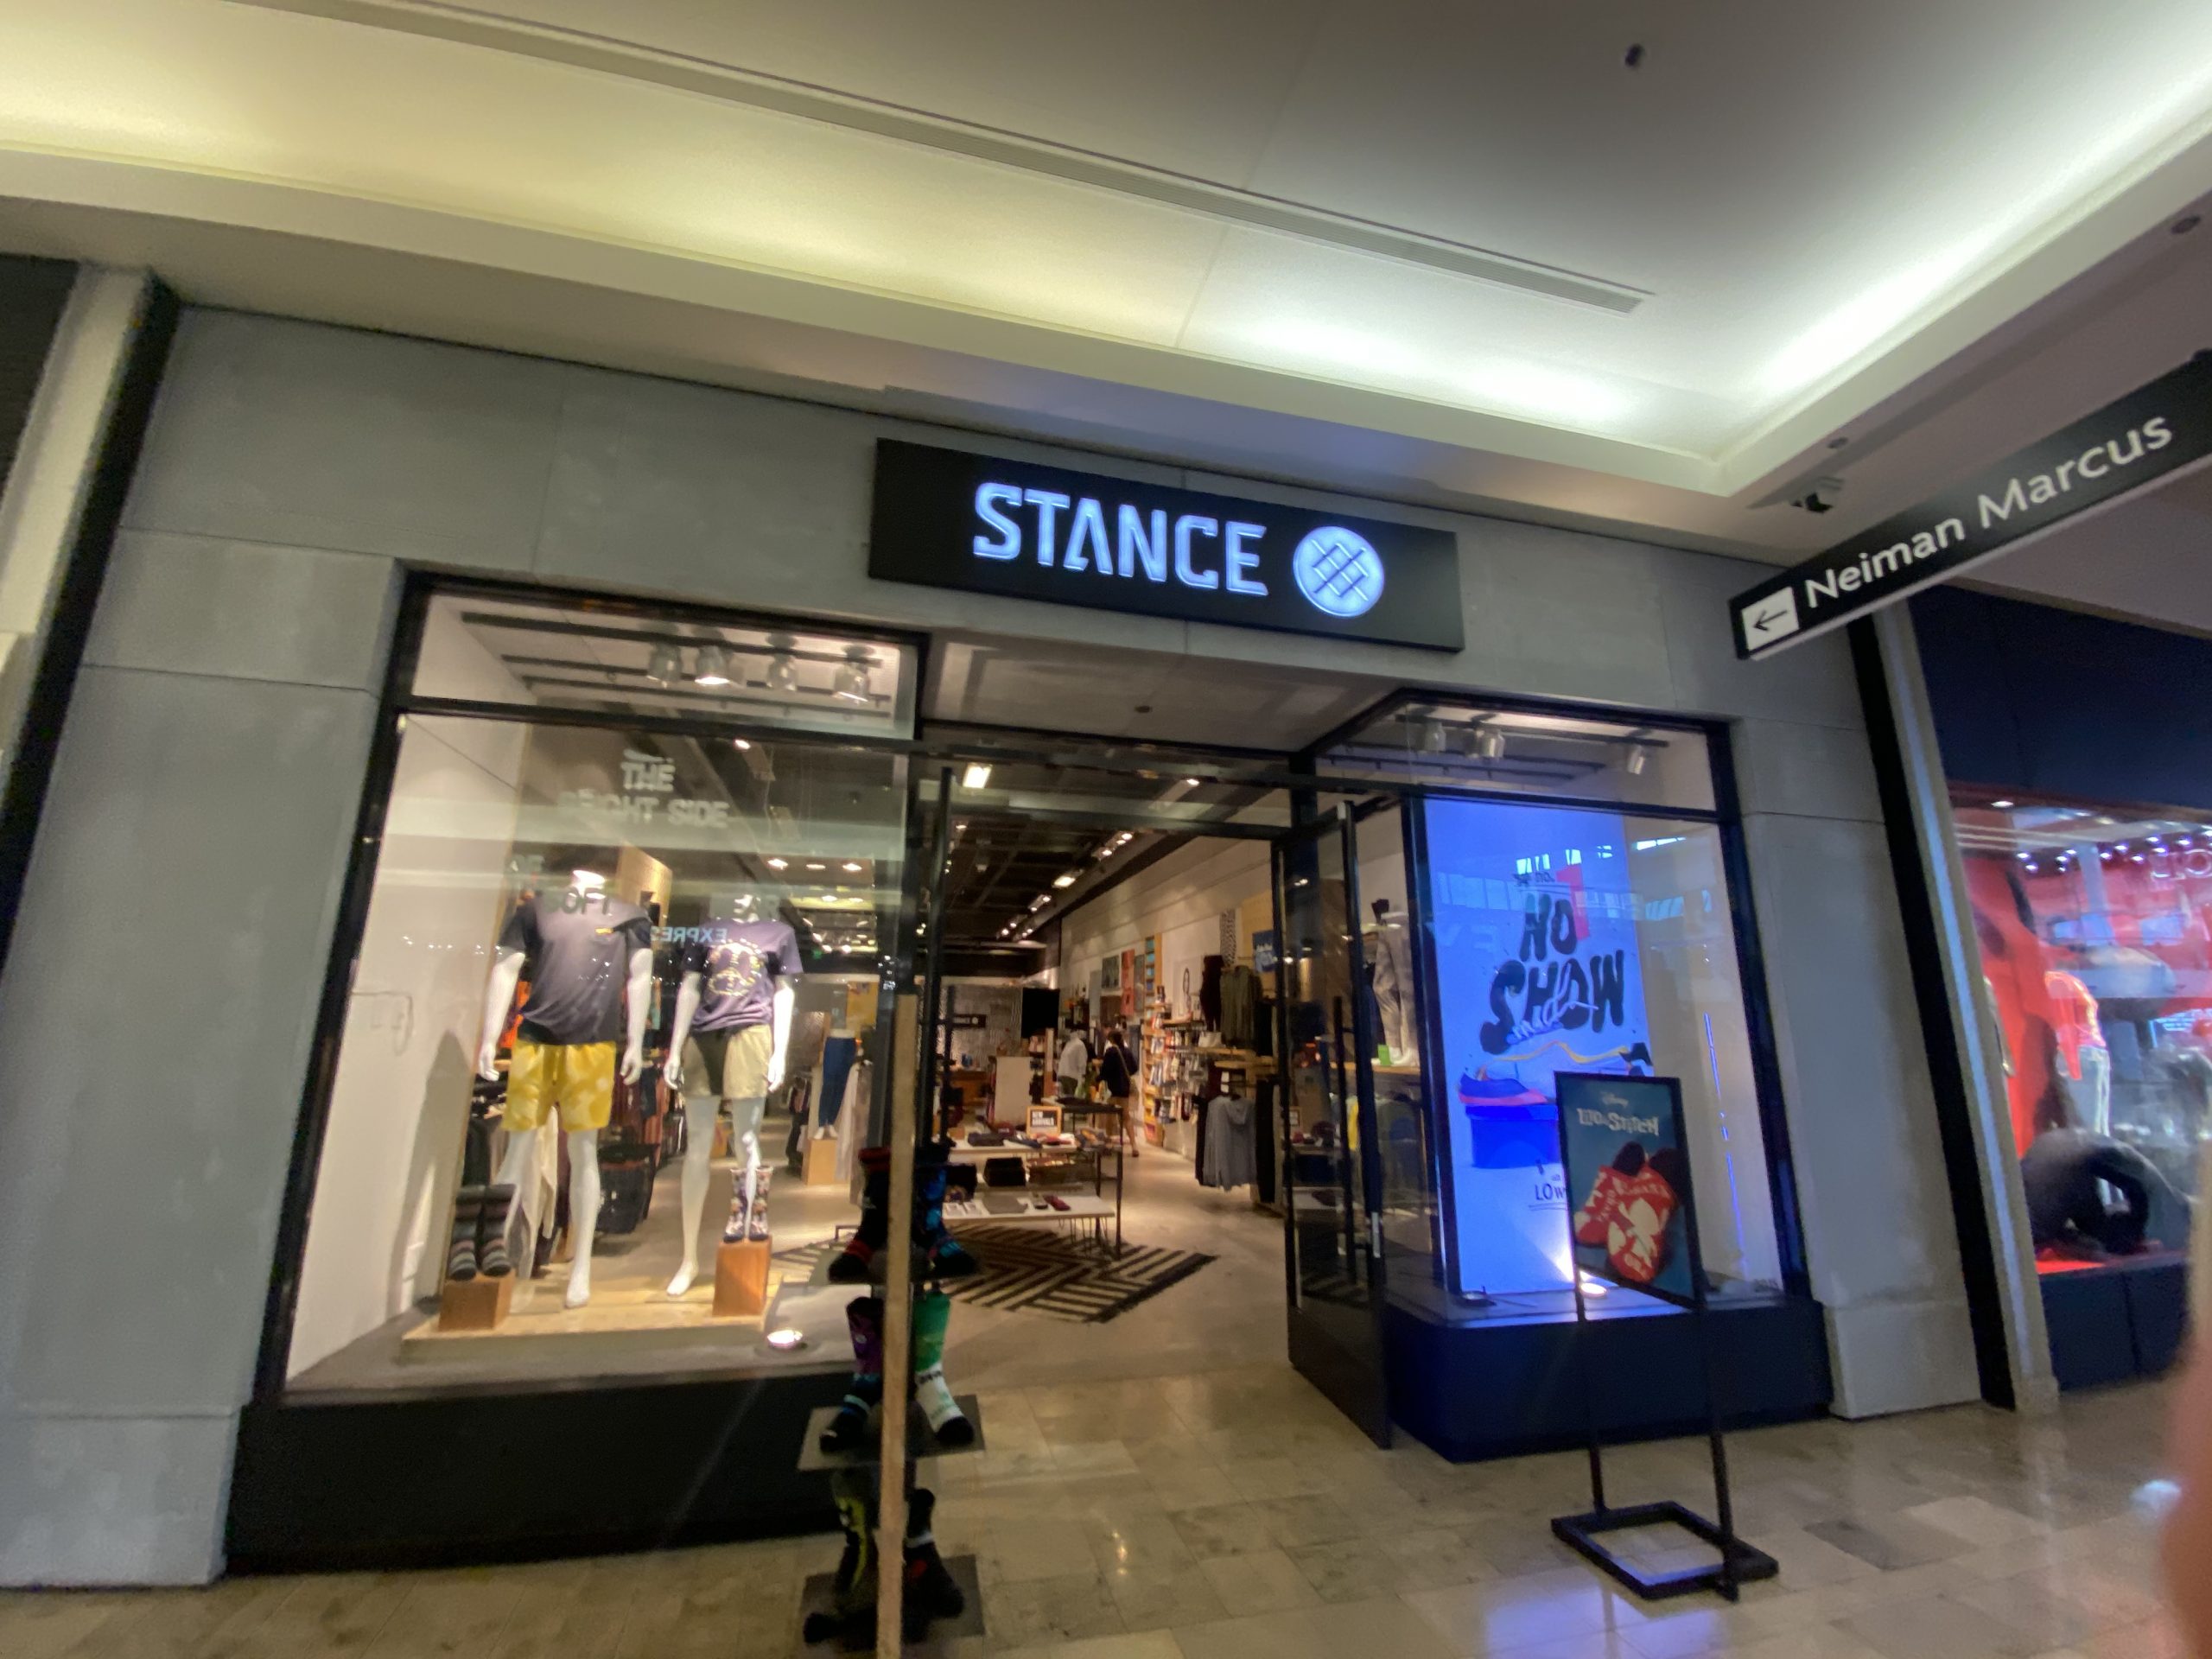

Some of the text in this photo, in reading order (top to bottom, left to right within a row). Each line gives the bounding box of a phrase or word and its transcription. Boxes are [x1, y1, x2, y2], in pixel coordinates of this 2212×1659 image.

[973, 481, 1268, 596] STANCE
[1805, 416, 2172, 608] Neiman Marcus
[620, 761, 677, 791] THE
[668, 799, 730, 829] SIDE
[1519, 893, 1577, 962] NO
[1479, 950, 1624, 1055] SHOW
